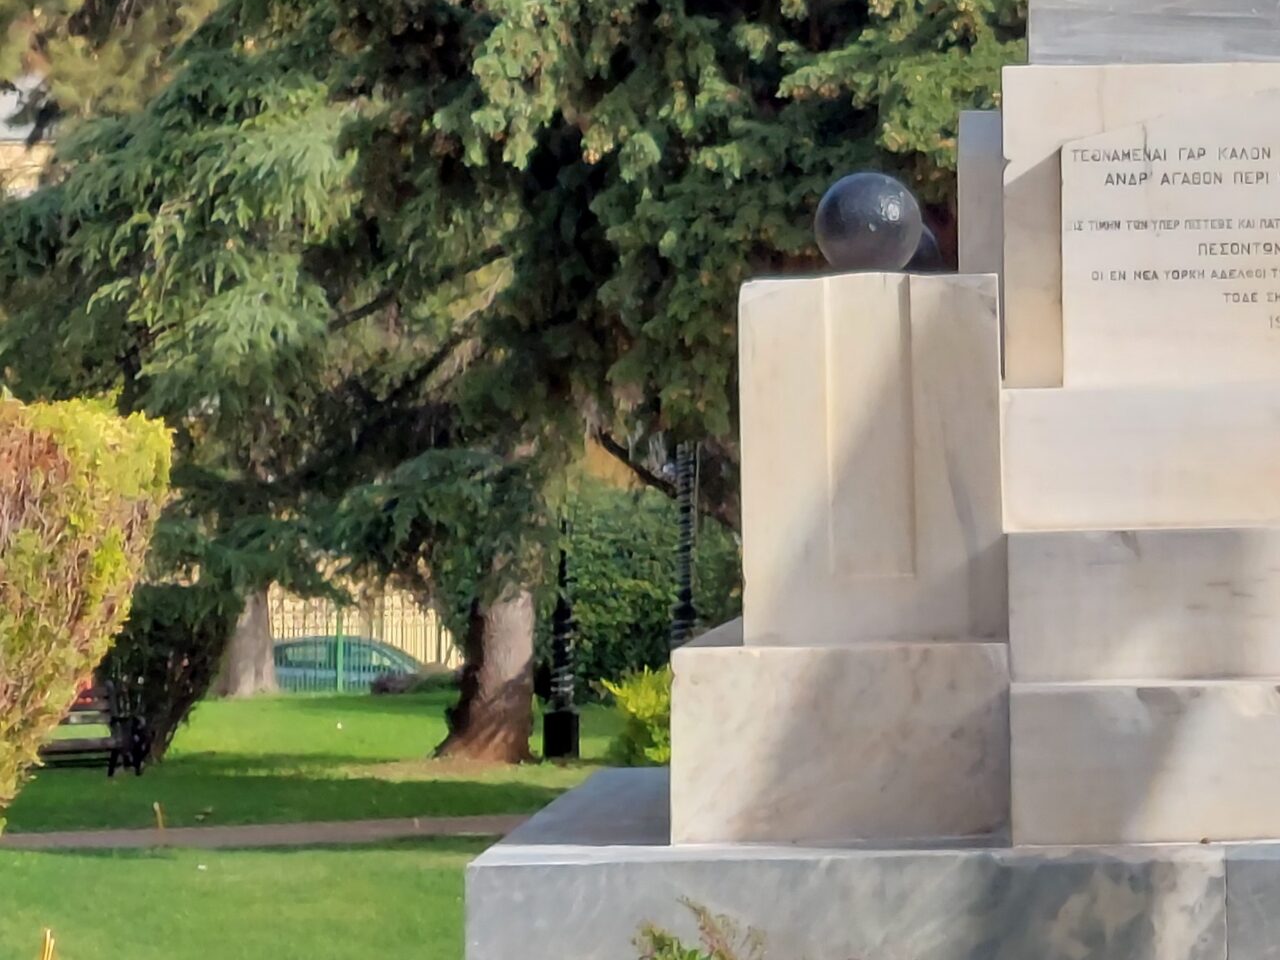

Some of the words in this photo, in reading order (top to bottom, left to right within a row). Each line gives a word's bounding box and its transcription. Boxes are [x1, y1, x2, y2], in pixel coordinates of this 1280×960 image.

[1072, 148, 1167, 162] ΤΕΘΝΑΜΕΝΑΙ
[1178, 148, 1206, 161] ΓΑΡ
[1218, 147, 1271, 160] ΚΑΛΟΝ
[1160, 172, 1222, 185] ΑΓΑΘΟΝ
[1234, 171, 1268, 184] ΠΕΡΙ
[1127, 219, 1148, 230] ΤΩΝ
[1152, 219, 1180, 230] ΥΠΕΡ
[1184, 219, 1232, 230] ΠΙΣΤΕΩΣ
[1238, 218, 1255, 229] ΚΑΙ
[1092, 271, 1103, 281] ΟΙ
[1110, 270, 1126, 281] ΕΝ
[1134, 270, 1159, 280] ΝΕΑ
[1164, 270, 1205, 280] ΥΟΡΚΗ
[1211, 269, 1266, 280] ΑΔΕΛΦΟΙ
[1223, 292, 1258, 303] ΤΟΔΕ
